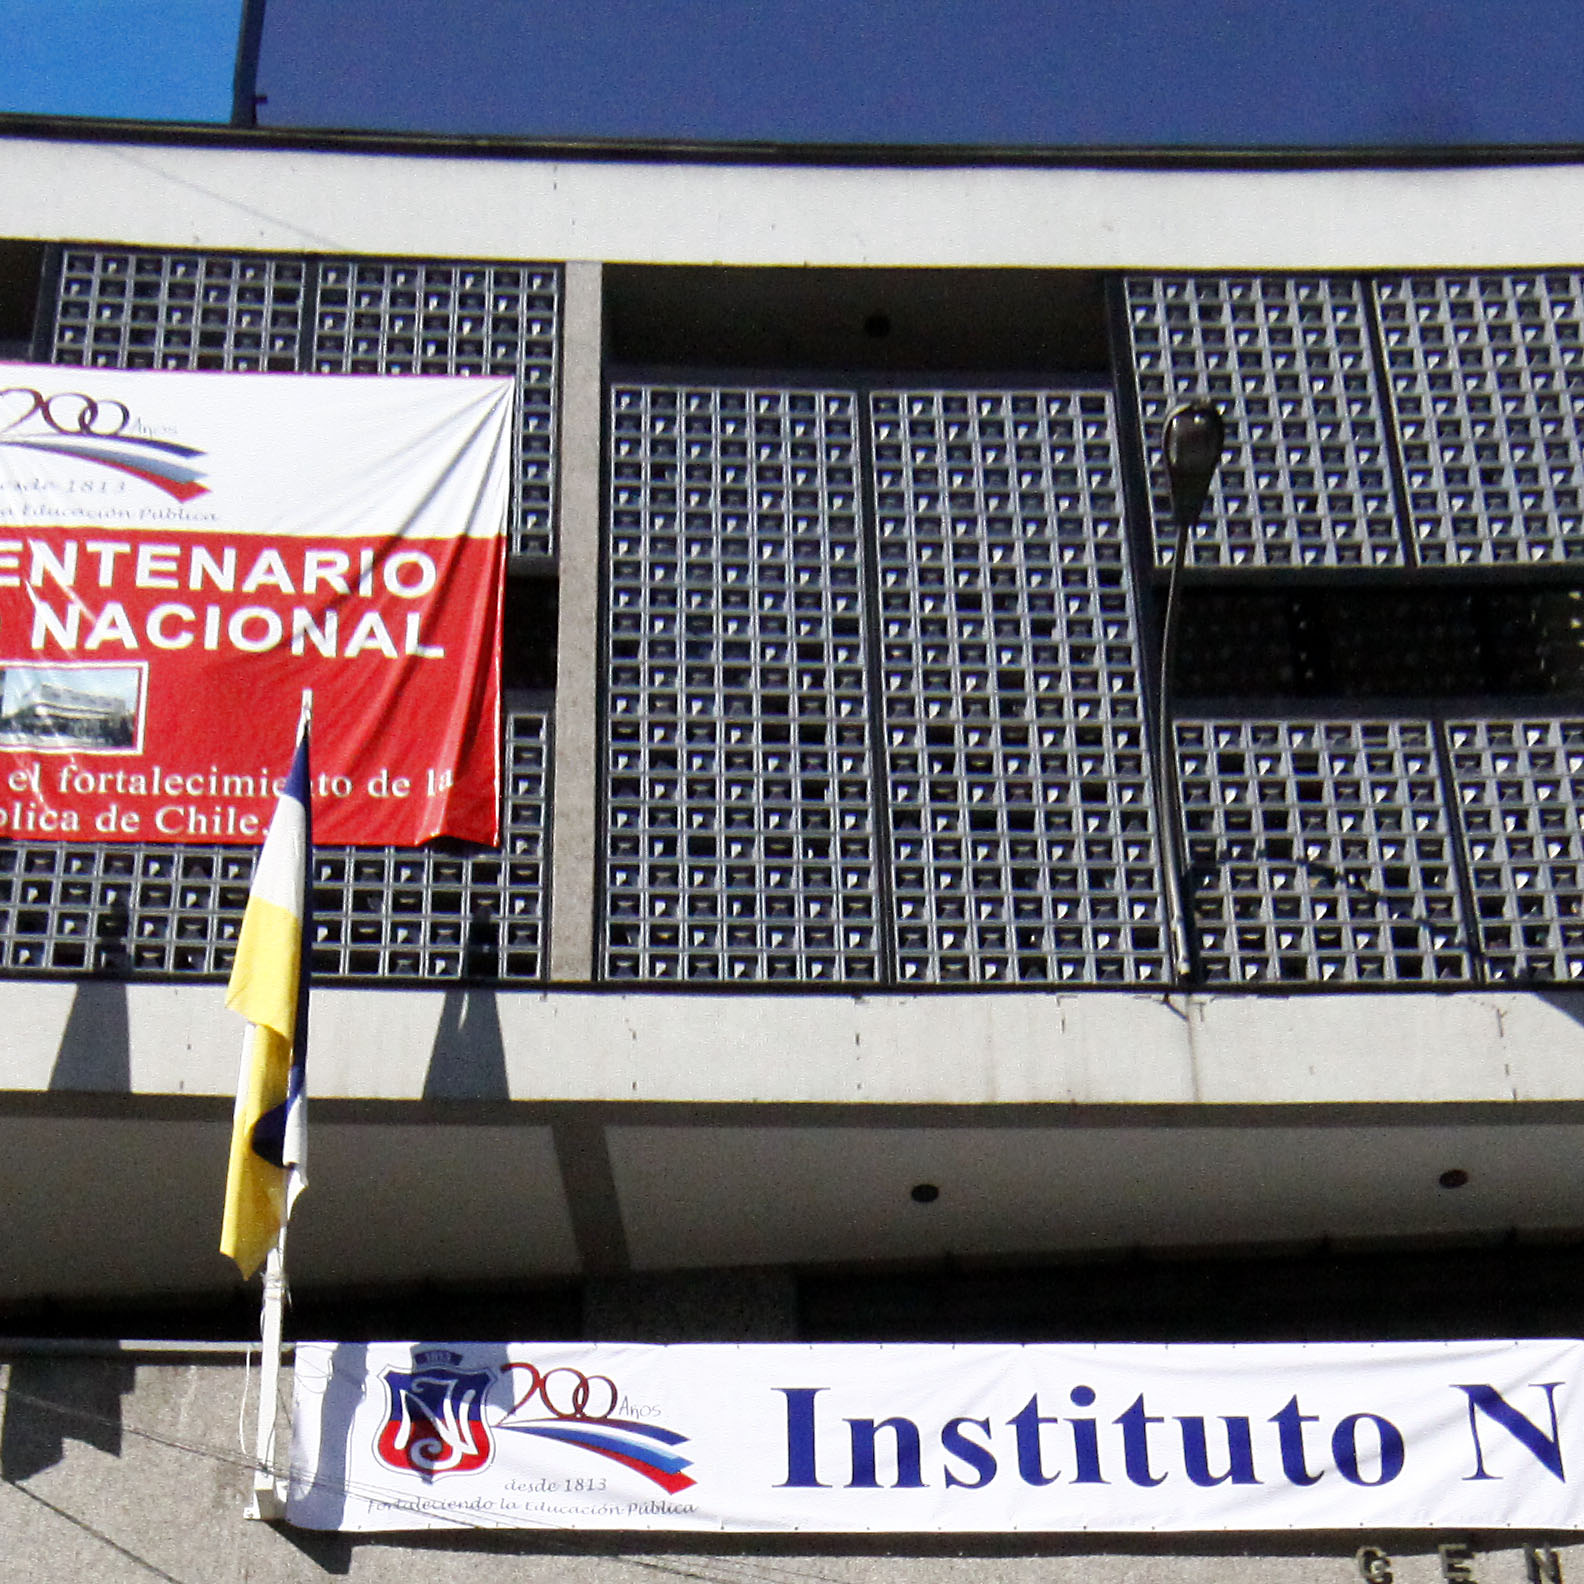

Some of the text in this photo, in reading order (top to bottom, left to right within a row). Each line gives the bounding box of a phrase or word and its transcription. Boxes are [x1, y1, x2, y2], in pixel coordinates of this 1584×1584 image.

[66, 479, 127, 495] 1813
[27, 599, 446, 660] NACIONAL
[8, 762, 42, 792] el
[59, 757, 353, 798] fortalecimieto
[368, 768, 411, 798] de
[427, 768, 454, 798] la
[96, 803, 140, 833] de
[155, 805, 270, 838] Chile.
[494, 1362, 618, 1425] 200
[771, 1383, 1406, 1491] Instituto
[504, 1476, 608, 1493] desde 1813
[367, 1496, 699, 1516] Fortaleciendo la Educación Pública
